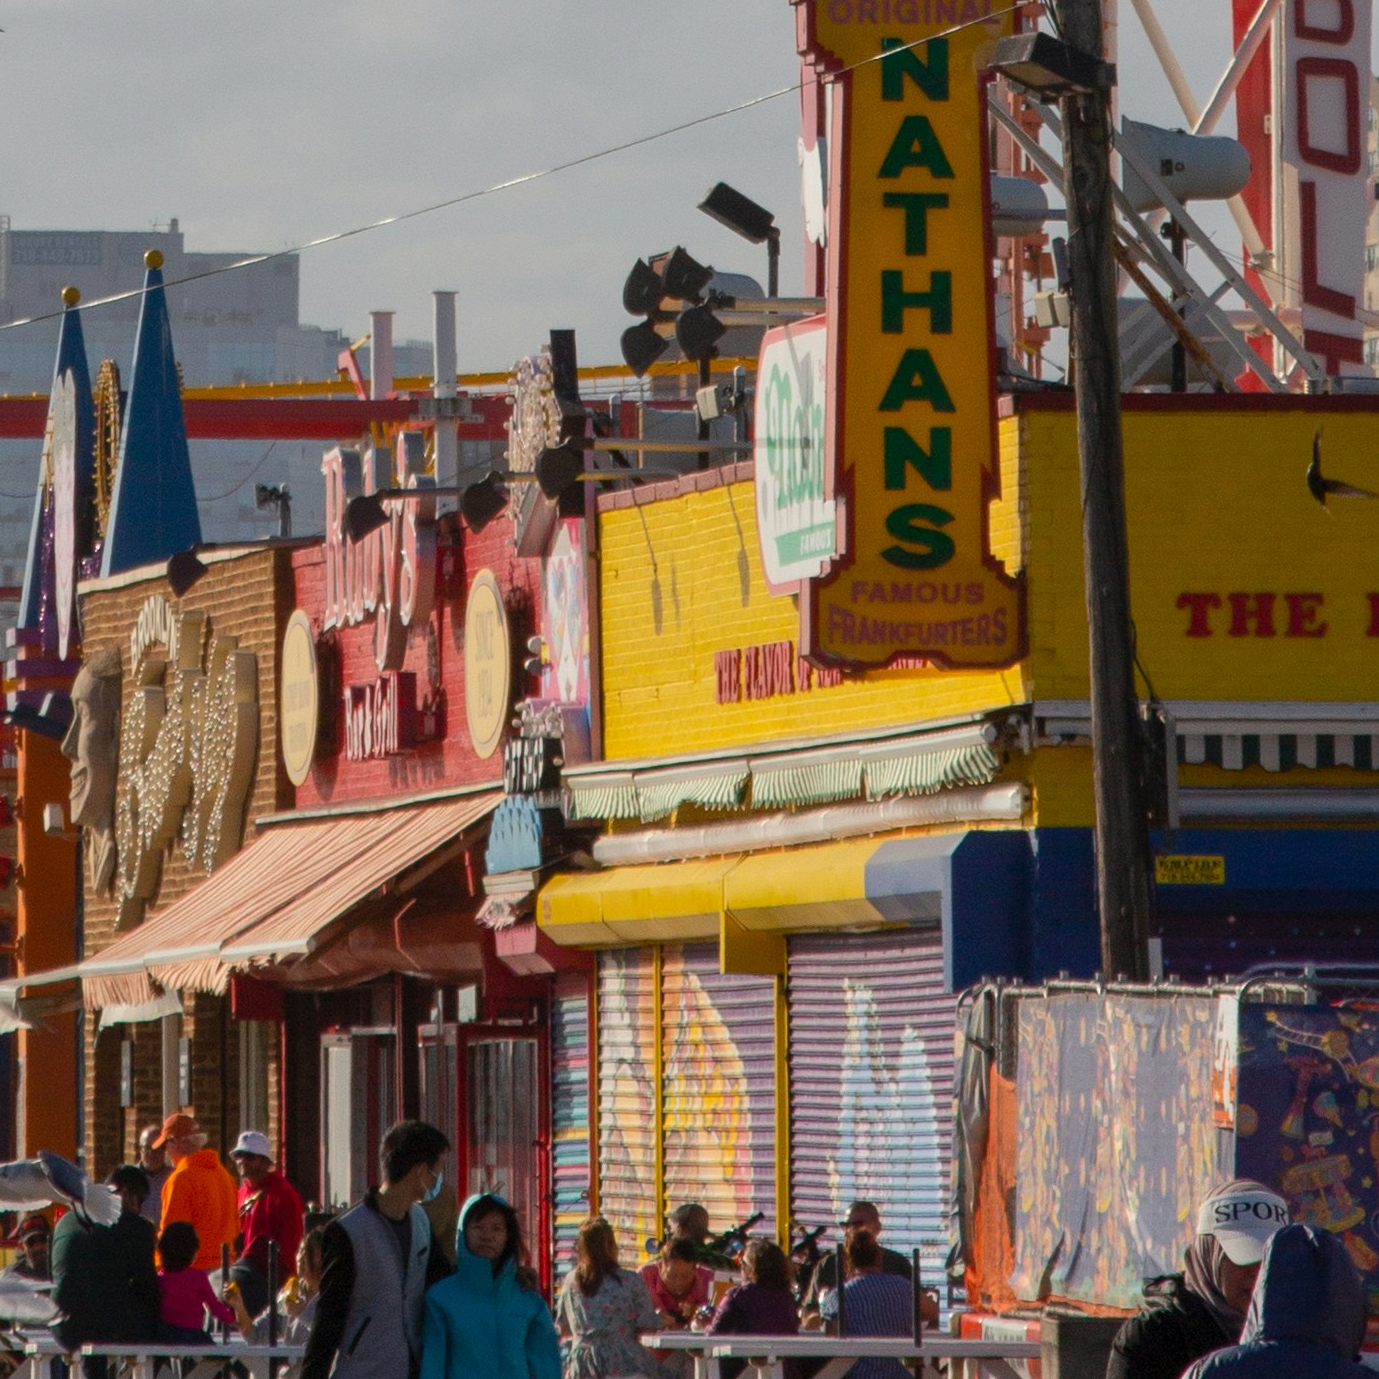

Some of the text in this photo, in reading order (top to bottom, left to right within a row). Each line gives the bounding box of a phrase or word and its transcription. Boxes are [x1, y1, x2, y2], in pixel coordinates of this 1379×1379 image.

[877, 38, 956, 570] NATHANS
[850, 580, 985, 605] FAMOUS
[827, 603, 1008, 645] FRANKFURTERS
[1176, 593, 1329, 639] THE
[714, 648, 742, 705] THE
[743, 640, 795, 701] FLAVOR
